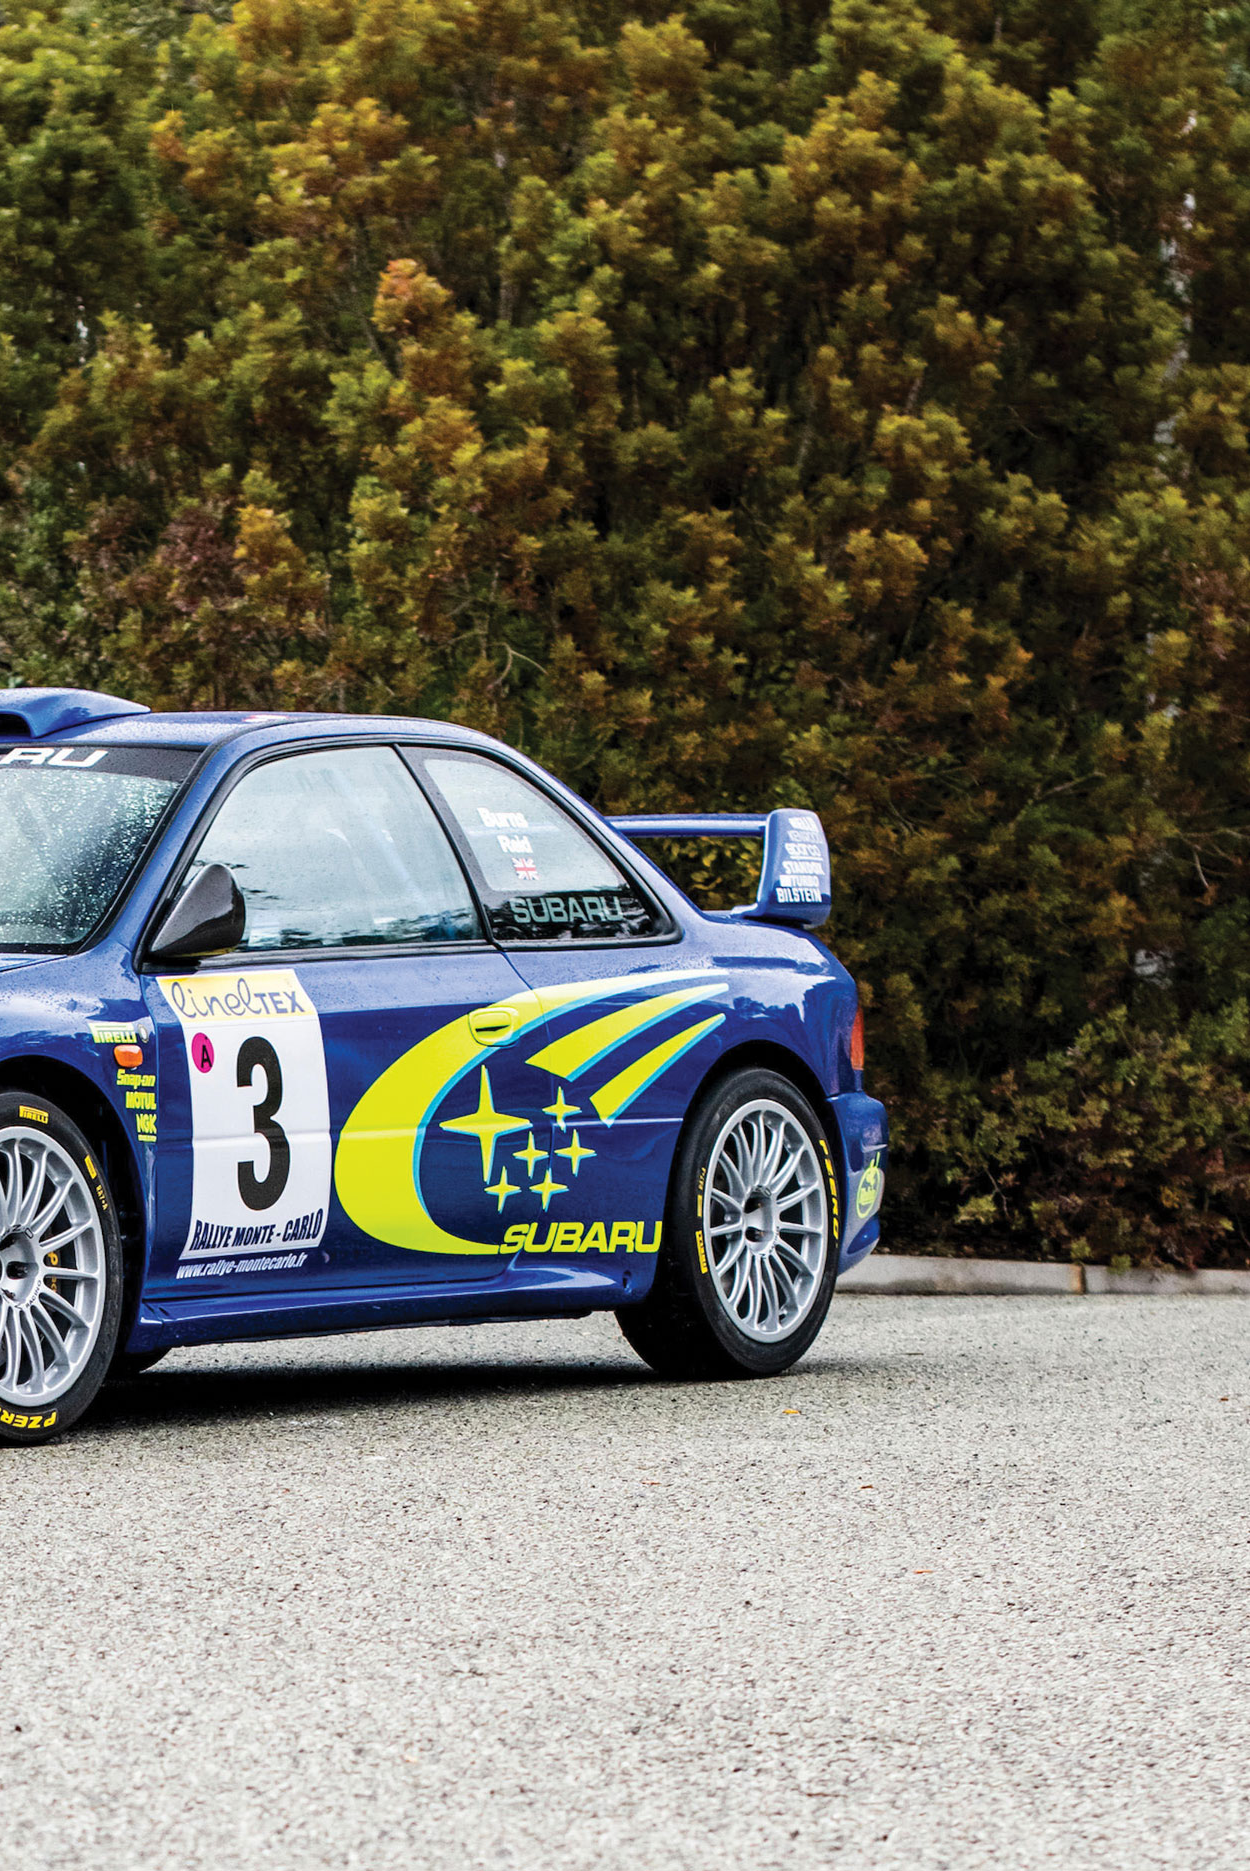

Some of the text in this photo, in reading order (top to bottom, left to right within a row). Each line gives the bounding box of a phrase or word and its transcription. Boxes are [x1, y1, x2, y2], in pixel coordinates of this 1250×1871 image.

[477, 807, 528, 828] Burns
[776, 887, 822, 903] BILSTEIN
[509, 896, 624, 923] SUBARU
[88, 1022, 137, 1043] PIRELLI
[201, 1045, 212, 1068] A
[125, 1091, 156, 1110] MOTUL
[136, 1114, 157, 1134] NGK
[236, 1036, 290, 1211] 3
[189, 1219, 233, 1250] RALLYE
[500, 1221, 663, 1254] SUBARU
[176, 1252, 308, 1279] www.rallye-montecarlo.fr
